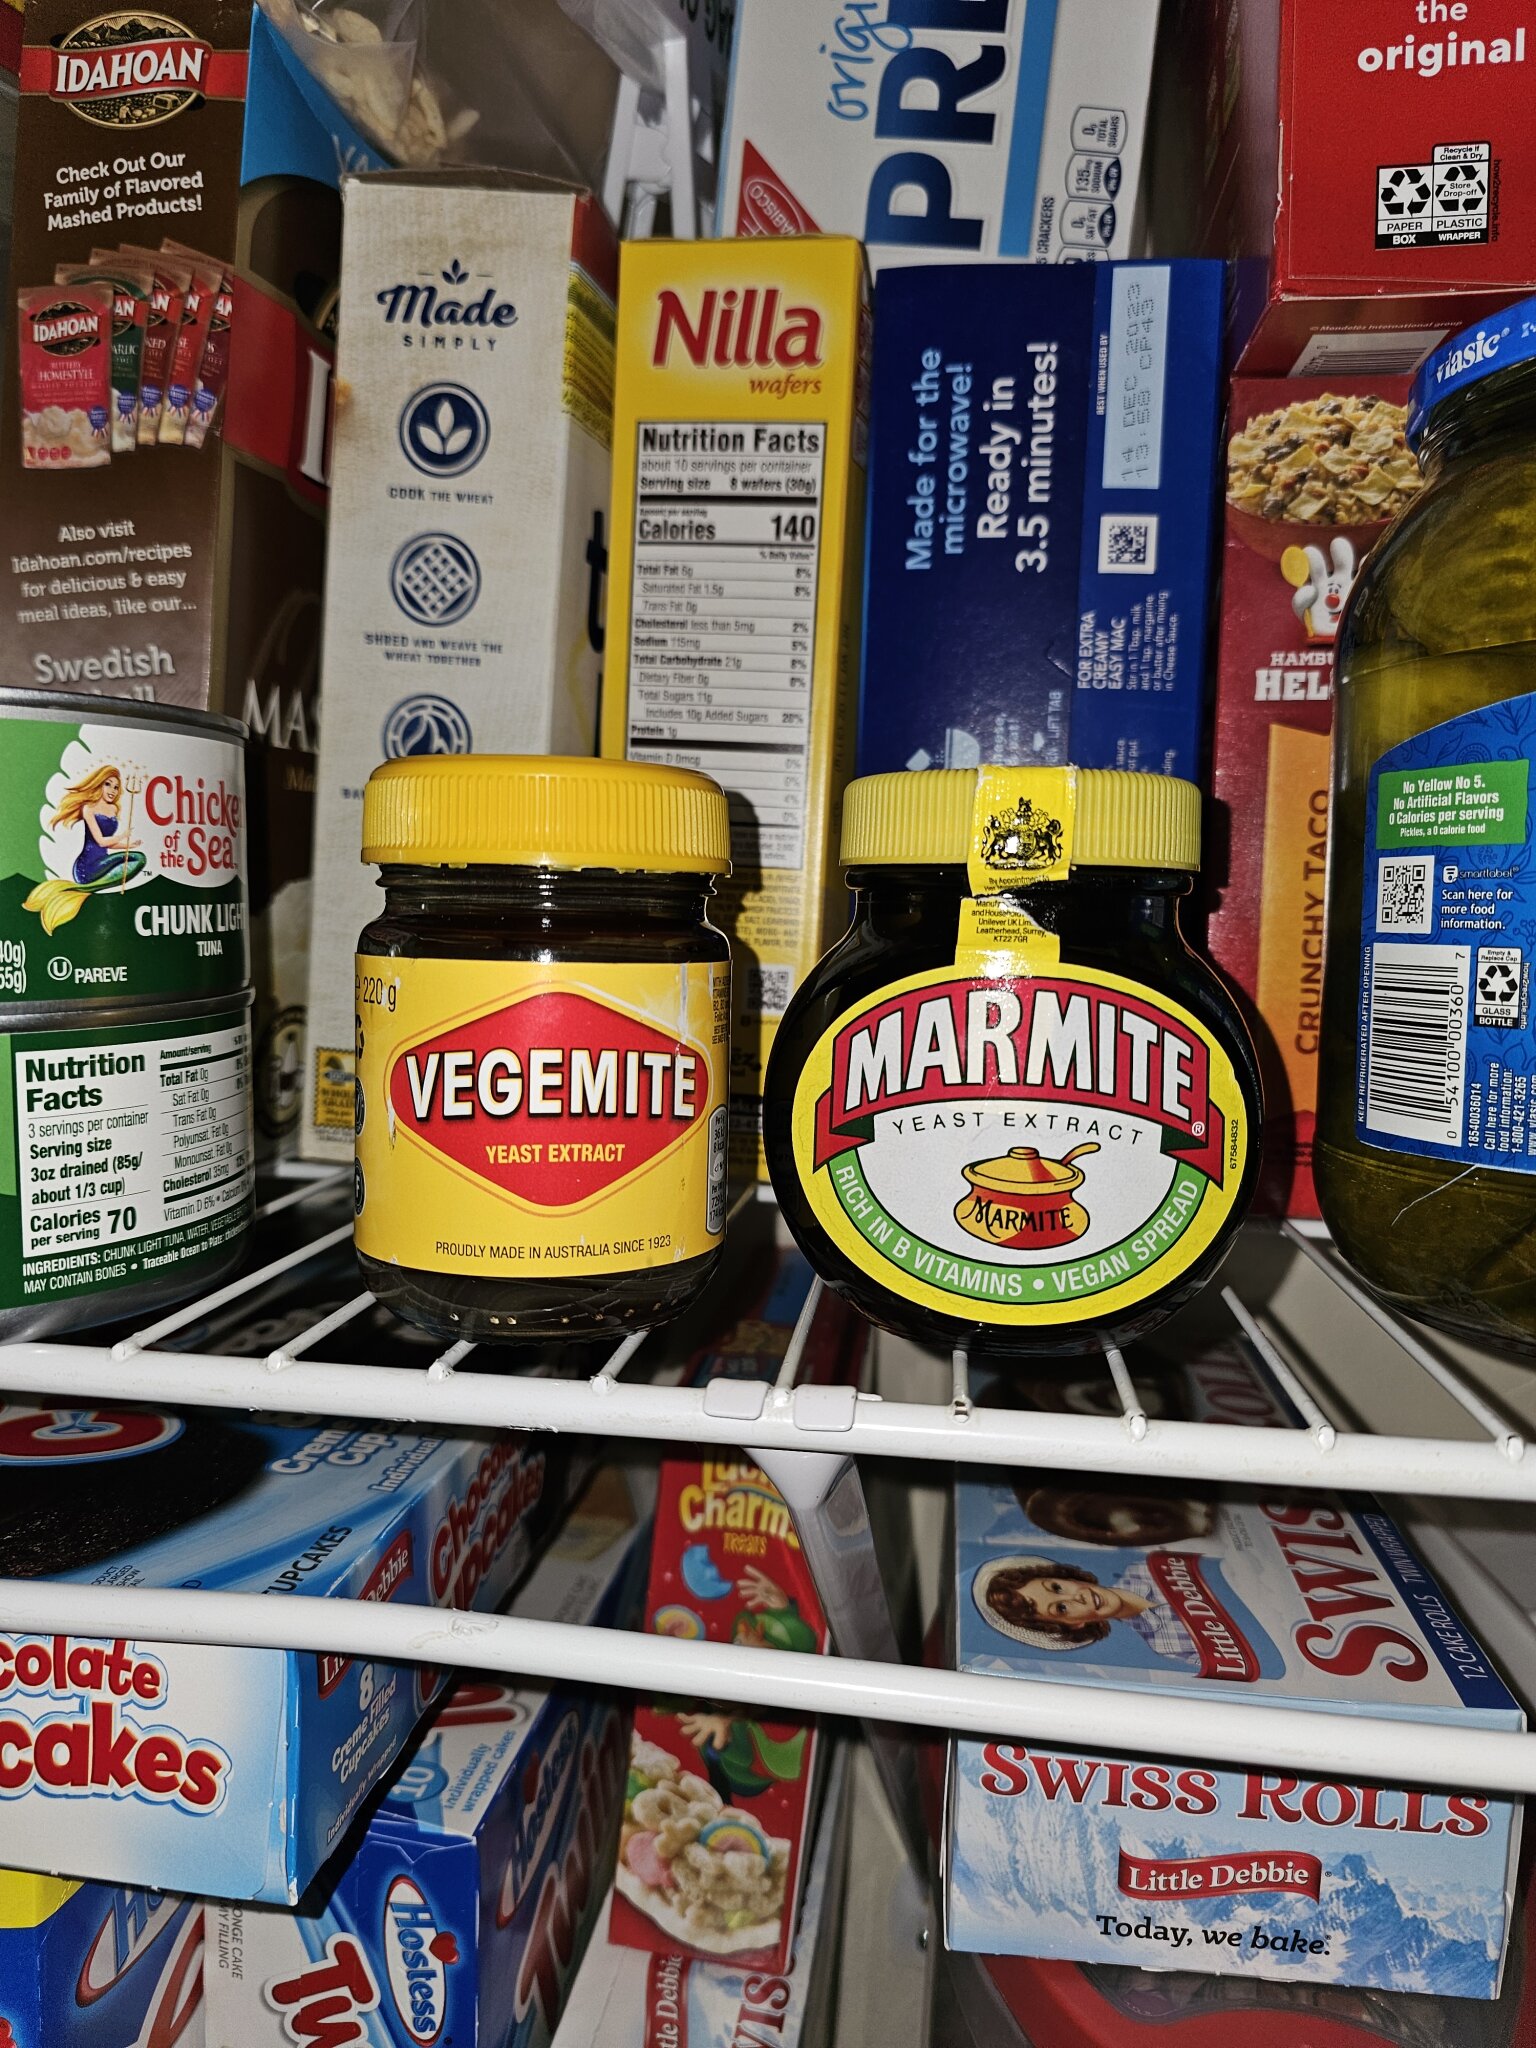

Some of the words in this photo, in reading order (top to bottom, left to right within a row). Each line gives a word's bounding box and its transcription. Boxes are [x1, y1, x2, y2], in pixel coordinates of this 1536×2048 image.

[1416, 0, 1468, 24] the
[1357, 28, 1526, 78] original
[56, 48, 204, 92] IDAHOAN
[56, 161, 109, 184] Check
[113, 156, 145, 175] Out
[150, 152, 185, 169] Our
[44, 185, 99, 210] Family
[103, 181, 122, 200] of
[126, 171, 204, 197] Flavored
[1444, 189, 1477, 198] Drop-off
[47, 205, 112, 231] Mashed
[117, 194, 202, 221] Products!
[1037, 197, 1054, 254] CRACKERS
[1387, 222, 1422, 232] PAPER
[1436, 218, 1482, 228] PLASTIC
[1393, 235, 1416, 245] BOX
[1439, 232, 1480, 241] WRAPPER
[377, 283, 518, 328] Made
[33, 316, 98, 342] IDAHOAN
[403, 335, 498, 351] SIMPLY
[652, 289, 823, 368] Nilla
[1099, 335, 1108, 345] BY
[1098, 348, 1107, 368] USED
[750, 373, 822, 399] wafers
[912, 348, 942, 406] the
[1097, 370, 1107, 393] WHEN
[983, 376, 1016, 411] in
[1096, 396, 1106, 415] BEST
[1020, 342, 1059, 503] minutes!
[642, 428, 745, 452] Nutrition
[754, 429, 819, 452] Facts
[909, 416, 938, 466] for
[939, 363, 973, 555] microwave!
[389, 487, 425, 500] COOK
[432, 492, 451, 503] THE
[457, 493, 494, 505] WHEAT
[976, 424, 1021, 538] Ready
[58, 524, 96, 542] Also
[98, 520, 135, 539] visit
[639, 519, 715, 541] Calories
[771, 515, 815, 541] 140
[905, 480, 936, 570] Made
[11, 544, 192, 573] Idahoan.com/recipes
[1015, 516, 1049, 573] 3.5
[21, 581, 46, 598] for
[50, 574, 126, 595] delicious
[131, 573, 143, 587] &
[148, 570, 187, 589] easy
[1079, 610, 1096, 657] EXTRA
[1110, 616, 1127, 651] MAC
[35, 644, 175, 684] Swedish
[1077, 660, 1092, 689] FOR
[1092, 632, 1108, 689] CREAMY
[1108, 655, 1122, 690] EASY
[1403, 781, 1415, 794] No
[1417, 778, 1452, 792] Yellow
[1456, 777, 1470, 789] No
[1473, 774, 1485, 788] 5.
[1389, 814, 1395, 825] 0
[1396, 811, 1436, 824] Calories
[1438, 810, 1457, 823] per
[1459, 808, 1504, 821] serving
[1393, 798, 1404, 810] No
[1407, 796, 1452, 809] Artificial
[1455, 792, 1499, 805] Flavors
[164, 830, 181, 852] of
[1302, 789, 1330, 881] TACO
[1400, 827, 1425, 838] Pickles,
[1433, 826, 1438, 835] 0
[1440, 825, 1465, 835] calorie
[1467, 824, 1485, 833] food
[161, 852, 184, 867] the
[187, 827, 234, 876] Sea
[1442, 890, 1464, 901] Scan
[1467, 890, 1494, 901] here
[1497, 890, 1513, 899] for
[1442, 905, 1467, 915] more
[1471, 904, 1495, 915] food
[135, 903, 213, 936] CHUNK
[1441, 918, 1506, 930] information.
[197, 940, 223, 956] TUNA
[75, 966, 128, 984] PAREVE
[1295, 891, 1325, 1055] CRUNCHY
[1363, 946, 1371, 989] OPENING
[1361, 992, 1369, 1022] AFTER
[1482, 1007, 1511, 1015] GLASS
[1520, 962, 1530, 1029] how2recycle.info
[1479, 1017, 1513, 1026] BOTTLE
[160, 1044, 211, 1059] Amount/serving
[845, 990, 1193, 1122] MARMITE
[1358, 1024, 1368, 1095] REFRIGERATED
[25, 1053, 146, 1083] Nutrition
[26, 1084, 103, 1112] Facts
[406, 1048, 696, 1120] VEGEMITE
[892, 1111, 984, 1135] YEAST
[1004, 1113, 1142, 1145] EXTRACT
[1468, 1083, 1481, 1147] 18540036014
[1512, 1076, 1526, 1153] 1-800-421-3265
[30, 1141, 82, 1159] Serving
[87, 1136, 112, 1151] size
[486, 1145, 541, 1163] YEAST
[549, 1144, 625, 1162] EXTRACT
[1229, 1118, 1239, 1170] 67584832
[31, 1168, 54, 1182] 3oz
[60, 1158, 108, 1178] drained
[112, 1151, 143, 1174] (85g/
[31, 1185, 70, 1204] about
[75, 1183, 96, 1199] 1/3
[100, 1177, 126, 1195] cup)
[30, 1209, 101, 1232] Calories
[107, 1206, 137, 1234] 70
[835, 1164, 870, 1220] RICH
[868, 1218, 893, 1246] IN
[893, 1239, 909, 1259] B
[915, 1251, 1022, 1297] VITAMINS
[962, 1195, 1075, 1238] MARMITE
[31, 1234, 51, 1250] per
[56, 1227, 100, 1244] serving
[435, 1241, 486, 1258] PROUDLY
[490, 1246, 525, 1259] MADE
[530, 1246, 541, 1259] IN
[545, 1243, 610, 1259] AUSTRALIA
[613, 1239, 645, 1255] SINCE
[648, 1235, 671, 1251] 1923
[1052, 1252, 1131, 1294] VEGAN
[1136, 1179, 1199, 1262] SPREAD
[24, 1280, 46, 1294] MAY
[50, 1270, 93, 1290] CONTAIN
[96, 1263, 127, 1281] BONES
[1164, 1556, 1206, 1617] Debbie
[1202, 1618, 1246, 1677] Little
[359, 1664, 376, 1707] 8
[331, 1714, 369, 1772] Creme
[369, 1674, 396, 1718] Filled
[339, 1710, 391, 1783] Cupcakes
[980, 1740, 1218, 1815] SWISS
[1237, 1766, 1490, 1837] ROLLS
[1128, 1865, 1204, 1892] Little
[1208, 1863, 1309, 1888] Debbie
[1096, 1914, 1193, 1947] Today,
[1202, 1929, 1242, 1949] we
[1251, 1929, 1332, 1956] bake.
[391, 1902, 438, 2034] Hostess
